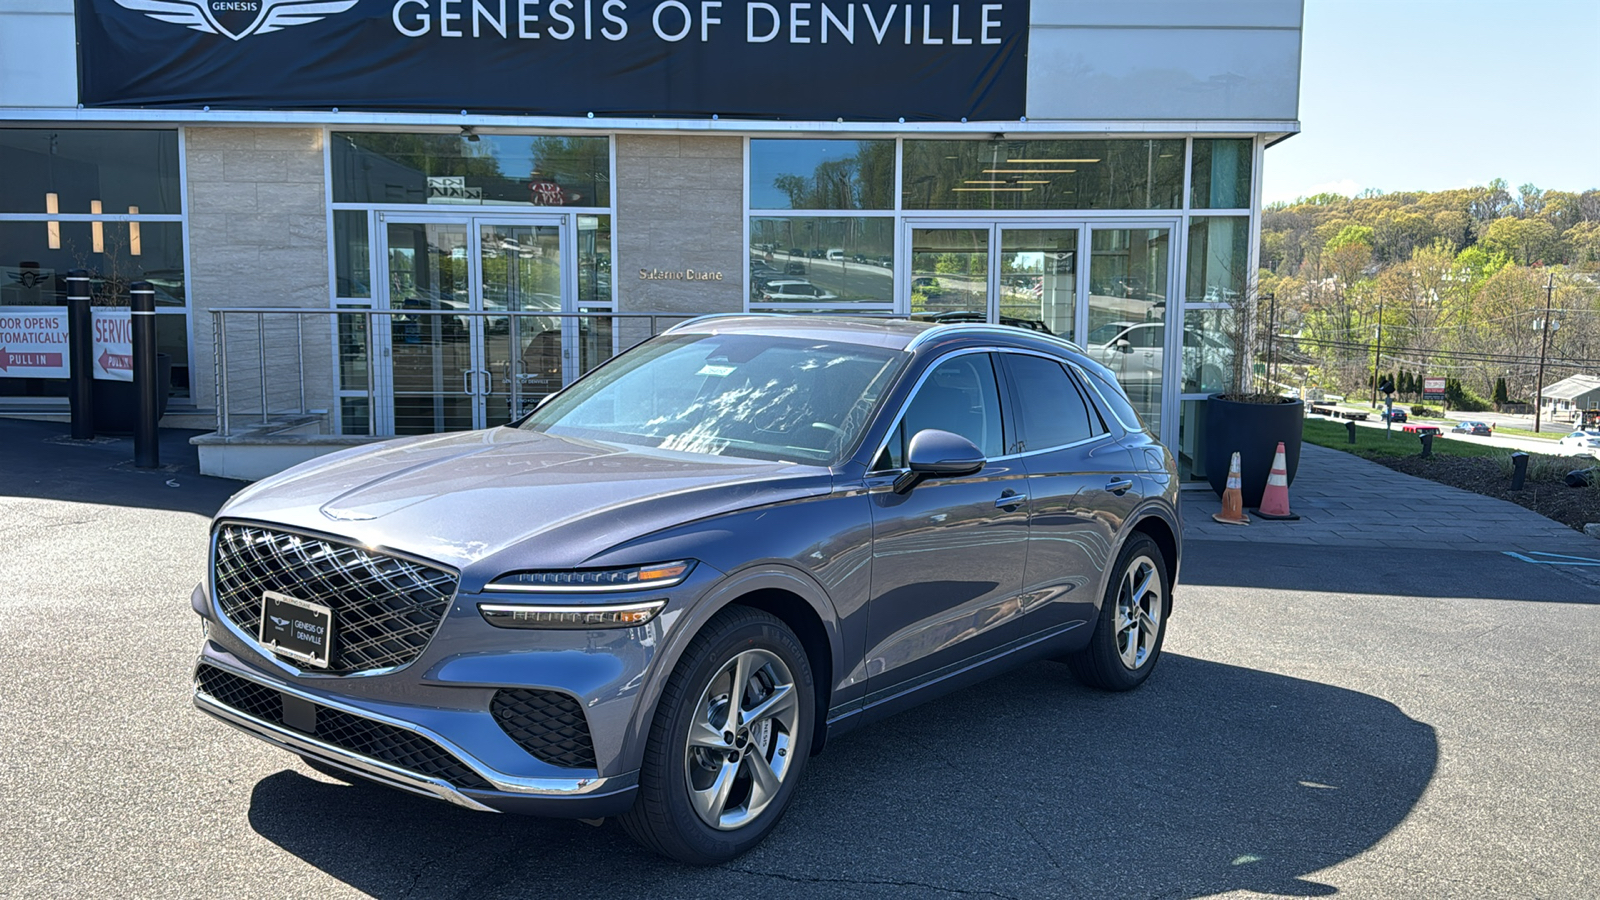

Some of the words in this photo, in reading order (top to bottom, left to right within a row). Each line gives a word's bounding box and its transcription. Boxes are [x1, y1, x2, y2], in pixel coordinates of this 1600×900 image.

[212, 2, 258, 11] GENESIS
[392, 0, 628, 41] GENESIS
[652, 0, 722, 42] OF
[746, 2, 1002, 45] DENVILLE
[639, 268, 683, 280] Salerno
[686, 269, 723, 280] Duane
[24, 317, 59, 329] OPENS
[9, 354, 33, 364] PULL
[36, 354, 47, 364] IN
[294, 620, 316, 633] GENESIS
[316, 626, 324, 635] OF
[296, 631, 322, 645] DENVILLE
